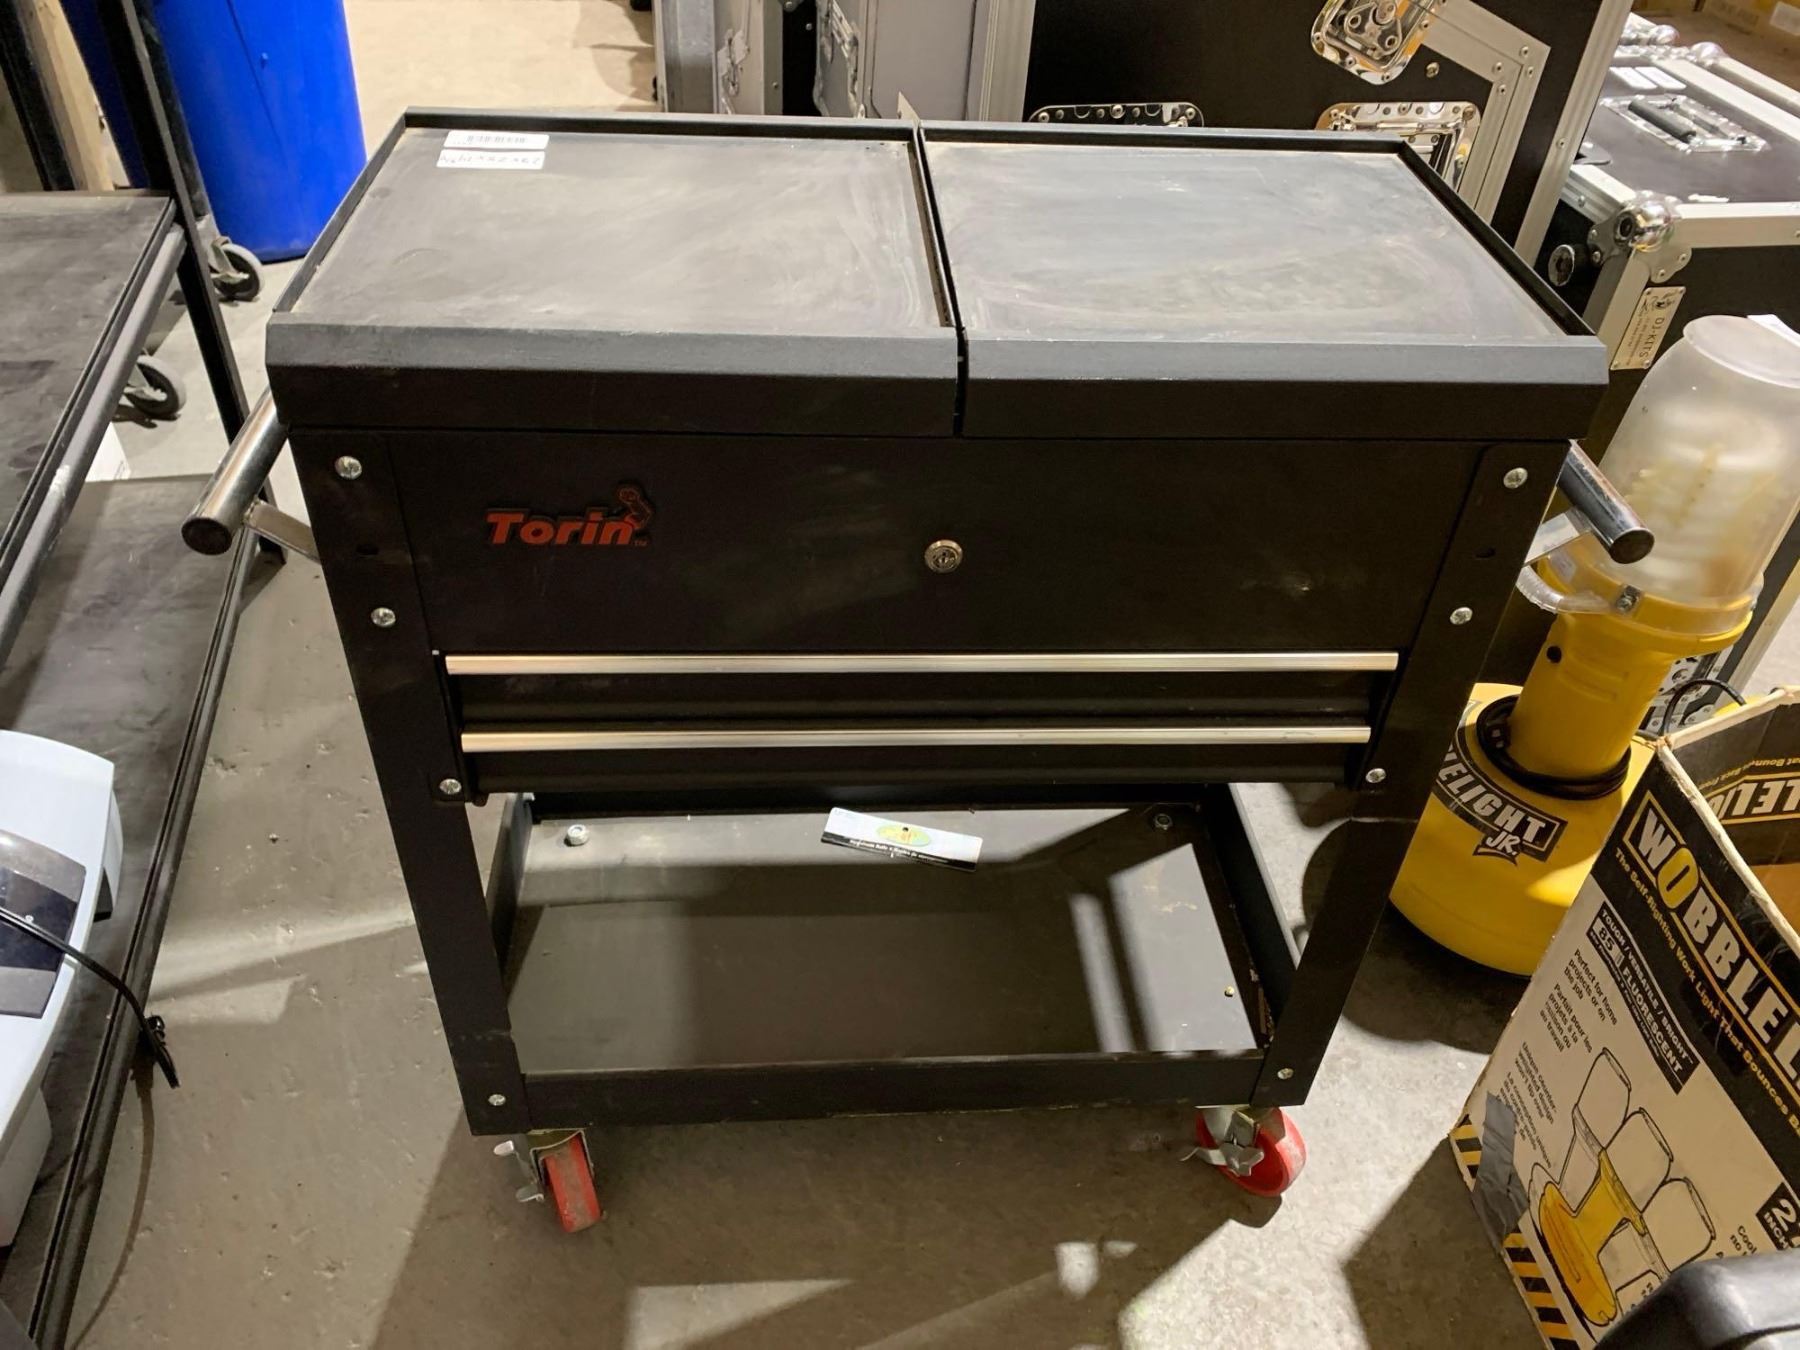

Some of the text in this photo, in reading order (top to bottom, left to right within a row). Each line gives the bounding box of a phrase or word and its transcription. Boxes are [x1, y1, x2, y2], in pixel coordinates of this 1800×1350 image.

[486, 511, 634, 545] Torin
[1598, 927, 1615, 951] 85
[1564, 966, 1583, 1000] the job
[1568, 959, 1606, 1021] projects or on
[1574, 949, 1617, 1025] Perfect for home
[1615, 847, 1630, 872] The
[1676, 946, 1695, 982] Work
[1695, 981, 1719, 1018] Light
[1720, 1016, 1743, 1051] That
[1743, 1050, 1788, 1114] Bounces
[1628, 952, 1659, 1009] VERSATILE
[1548, 993, 1568, 1025] projets
[1554, 983, 1593, 1053] Parfait pour les
[1623, 967, 1682, 1071] FLUORESCENT
[1547, 1021, 1564, 1052] travail
[1562, 1035, 1571, 1049] ou
